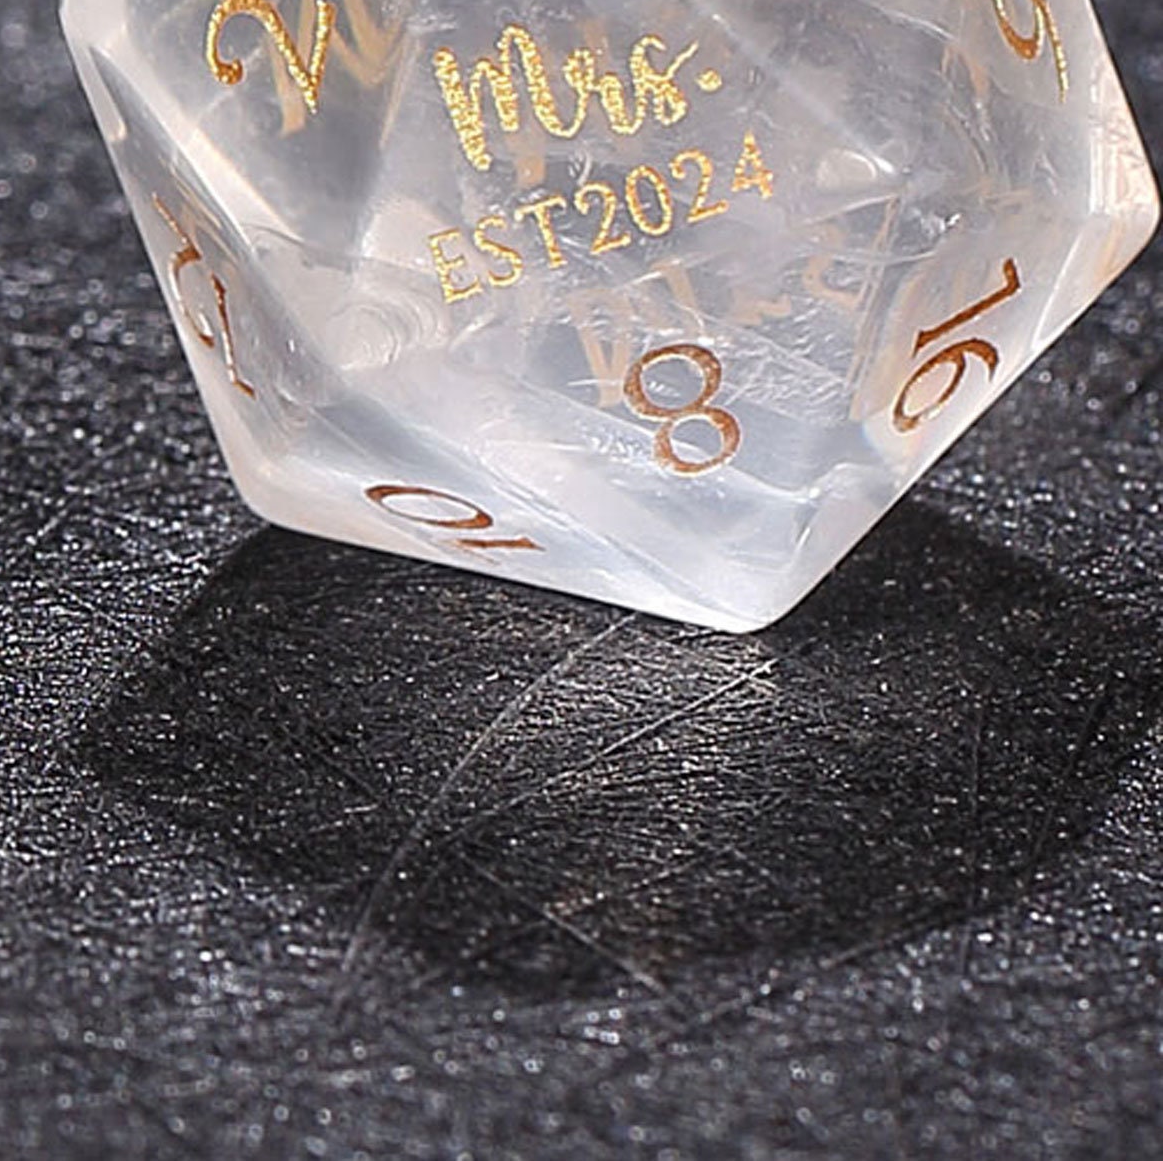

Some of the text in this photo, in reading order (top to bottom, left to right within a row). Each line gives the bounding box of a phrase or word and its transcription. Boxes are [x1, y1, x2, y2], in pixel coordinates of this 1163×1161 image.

[434, 24, 723, 171] Mrs.
[428, 130, 774, 305] EST2024
[623, 343, 743, 478] 8
[892, 257, 1021, 434] 16
